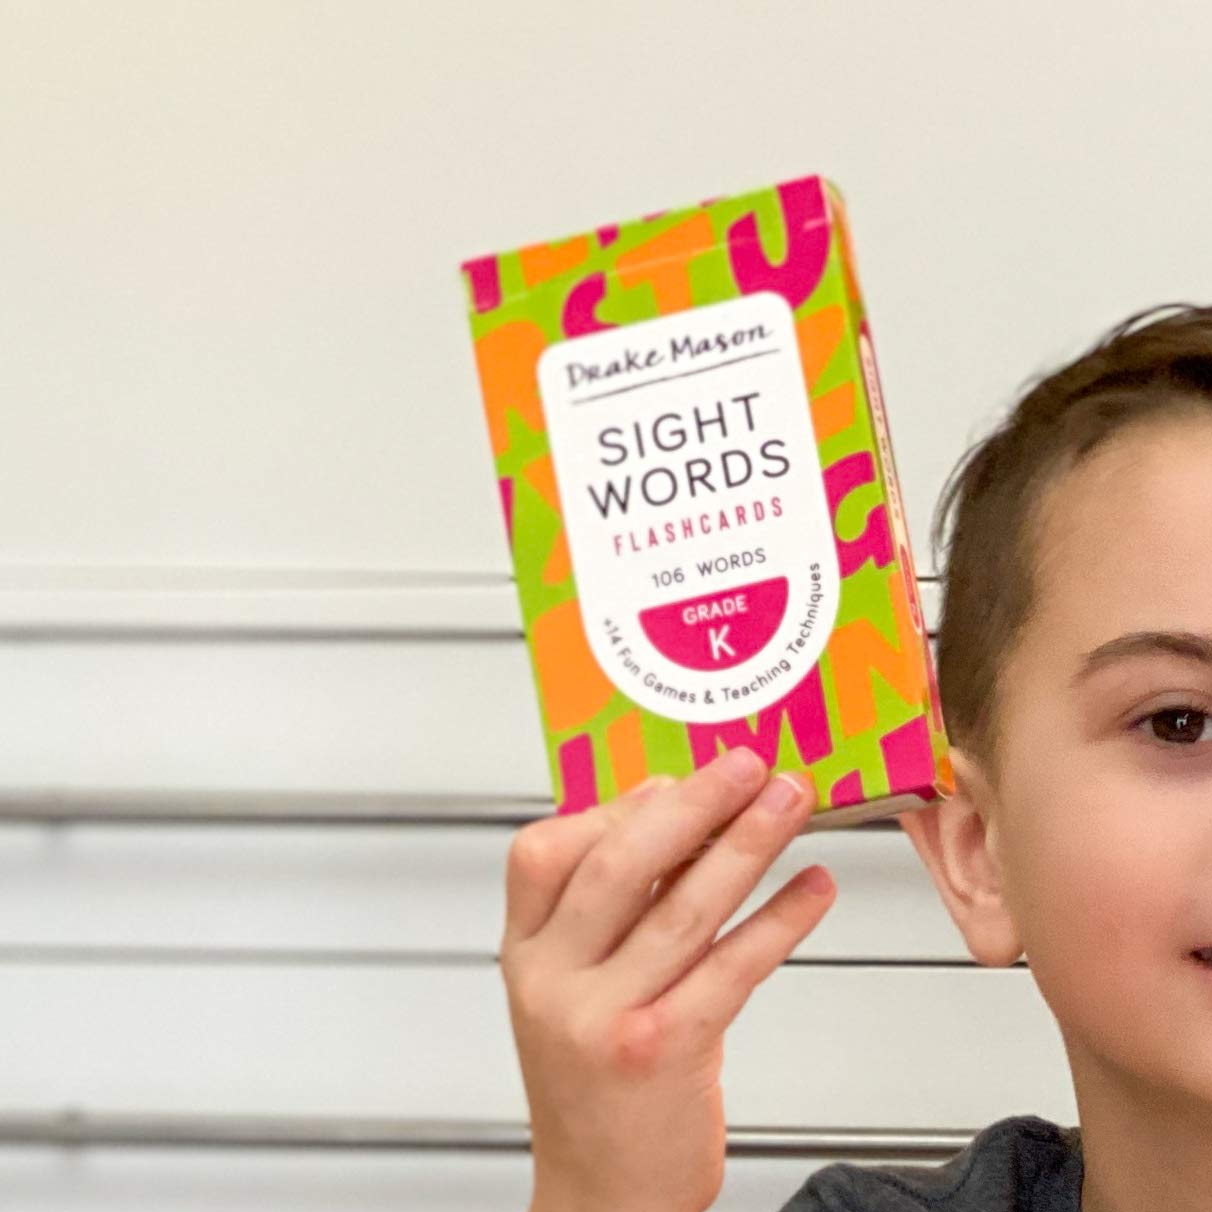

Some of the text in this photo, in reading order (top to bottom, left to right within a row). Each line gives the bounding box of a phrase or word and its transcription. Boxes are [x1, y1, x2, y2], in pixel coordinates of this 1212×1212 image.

[566, 323, 773, 389] Drake Mason
[598, 392, 760, 466] SIGHT
[588, 439, 791, 519] WORDS
[613, 496, 783, 556] FLASHCARDS
[651, 548, 767, 589] 106 WORDS
[617, 647, 641, 676] Fun
[643, 673, 697, 704] Games
[703, 690, 715, 704] &
[721, 658, 792, 702] Teaching
[786, 562, 824, 656] Techniques
[682, 594, 748, 625] GRADE
[709, 625, 736, 660] K
